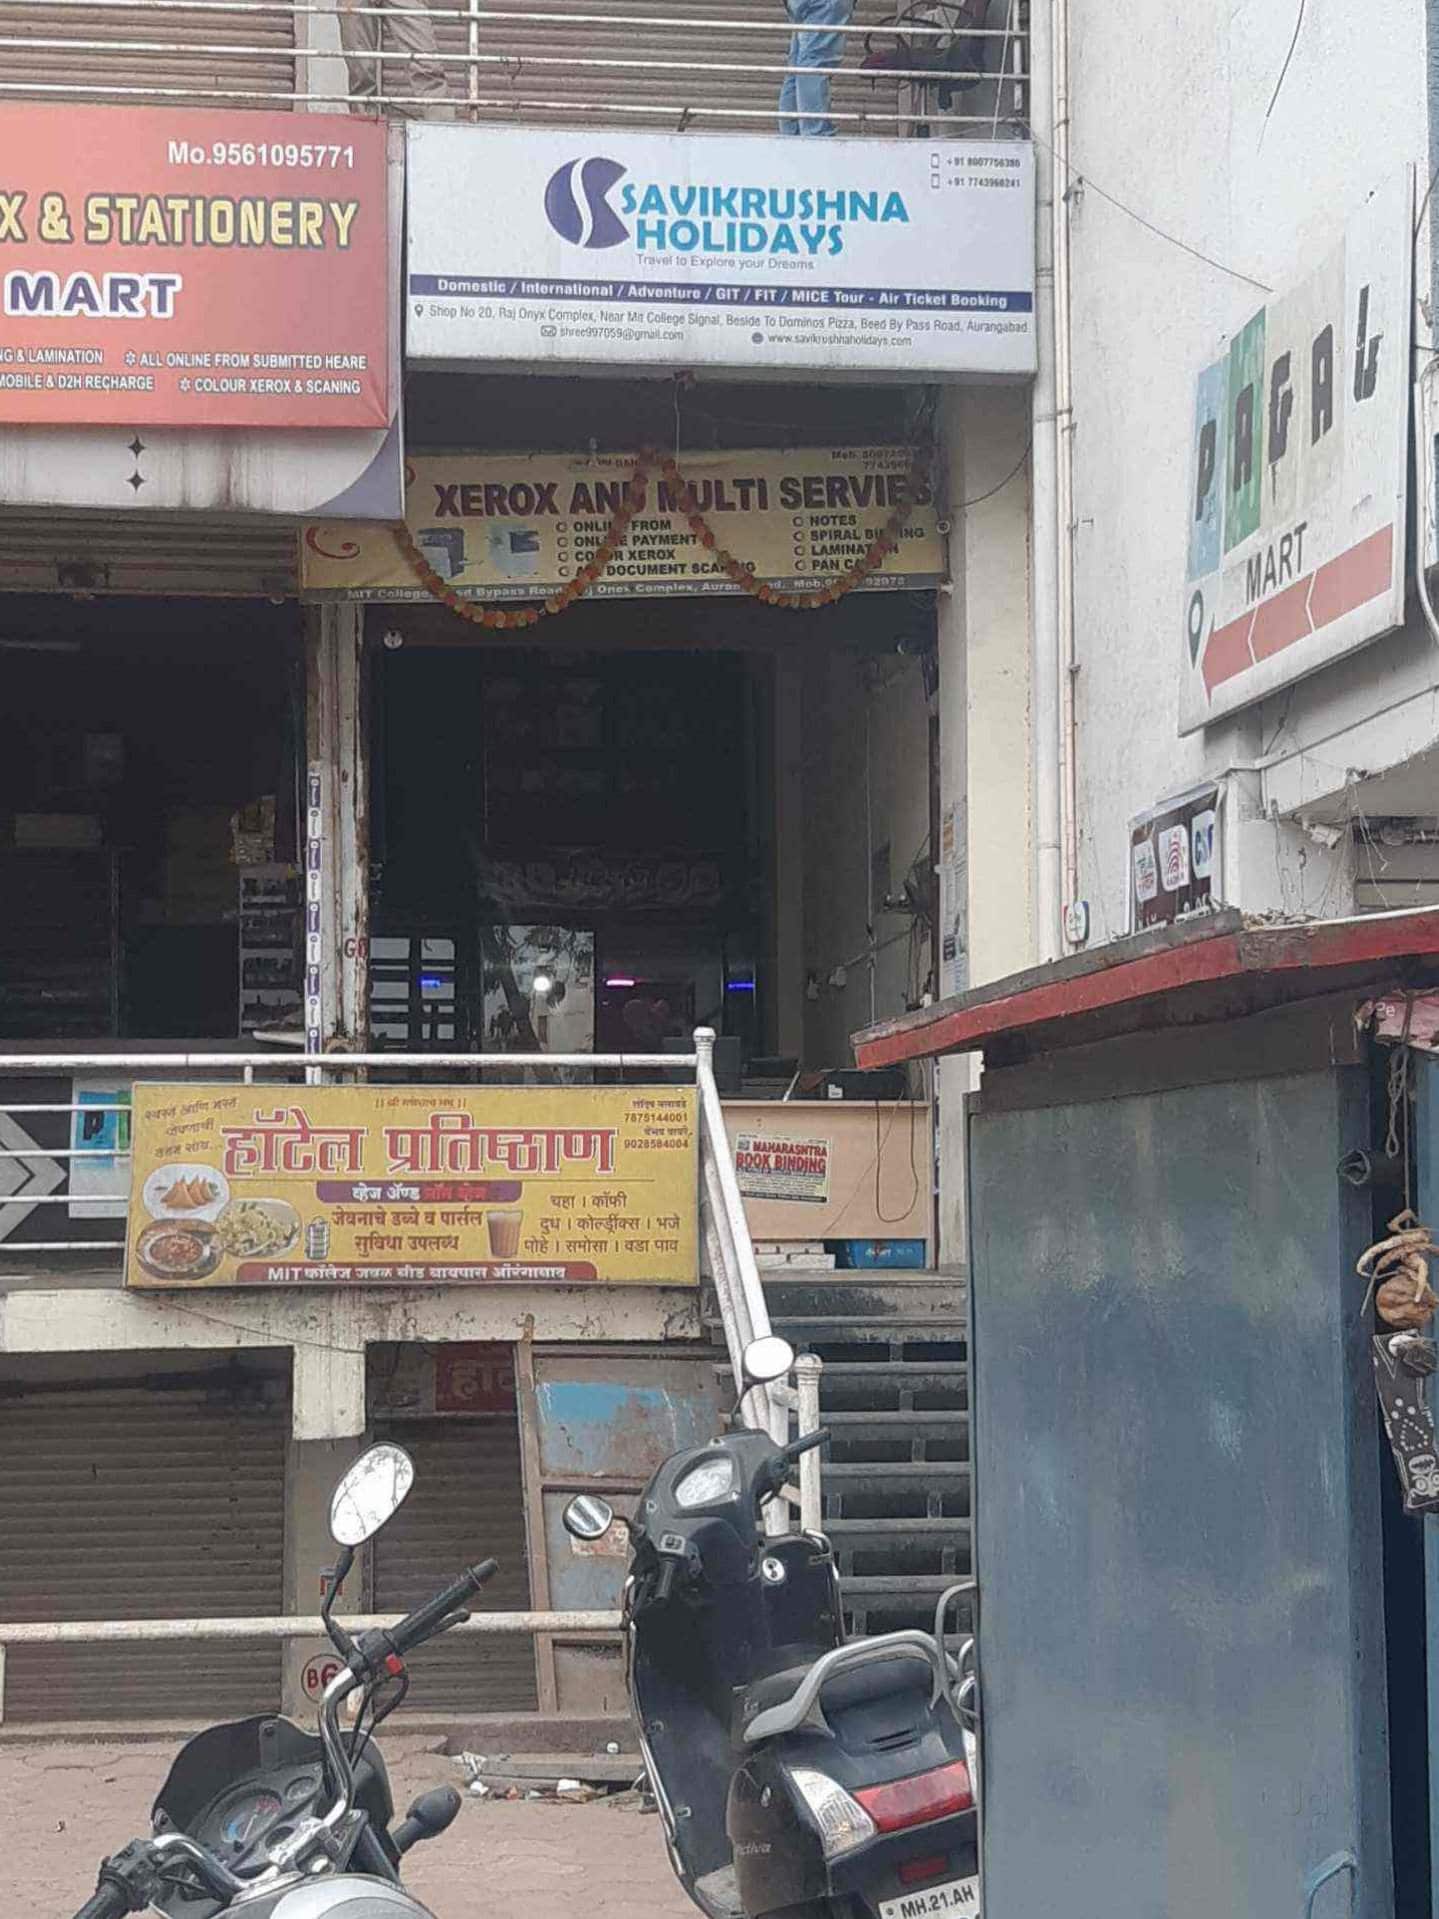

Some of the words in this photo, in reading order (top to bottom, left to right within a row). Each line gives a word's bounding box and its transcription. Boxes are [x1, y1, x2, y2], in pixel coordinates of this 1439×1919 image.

[167, 141, 355, 169] Mo.9561095771
[621, 183, 910, 224] SAVIKRUSHNA
[40, 194, 71, 242] &
[85, 195, 359, 249] STATIONERY
[636, 218, 843, 256] HOLIDAYS
[637, 254, 673, 266] Travel
[675, 255, 687, 266] to
[691, 256, 736, 269] Explore
[738, 259, 765, 271] your
[768, 257, 815, 270] Dreams
[6, 272, 180, 317] MART
[437, 278, 506, 294] Domestic
[521, 281, 613, 297] International
[628, 285, 701, 300] Adventure
[715, 289, 741, 301] GIT
[754, 289, 778, 301] FIT
[792, 290, 829, 303] MICE
[833, 291, 864, 304] Tour
[878, 293, 899, 305] Air
[904, 293, 946, 306] Ticket
[951, 294, 1007, 308] Booking
[429, 305, 457, 318] Shop
[460, 306, 475, 318] No
[519, 308, 546, 321] Onyx
[548, 309, 597, 323] Complex,
[600, 310, 624, 322] Near
[647, 311, 685, 326] College
[726, 314, 760, 326] Beside
[765, 315, 776, 327] To
[779, 316, 825, 328] Dominos
[861, 318, 886, 330] Beed
[889, 319, 903, 332] By
[906, 319, 931, 331] Pass
[967, 320, 1028, 334] Aurangabad
[29, 350, 104, 364] LAMINATION
[139, 353, 163, 367] ALL
[166, 353, 211, 368] ONLINE
[215, 354, 250, 368] FROM
[253, 355, 322, 370] SUBMITTED
[325, 355, 367, 370] HEARE
[58, 375, 82, 389] D2H
[85, 376, 154, 390] RECHARGE
[195, 379, 247, 393] COLOUR
[250, 379, 290, 393] XEROX
[306, 380, 361, 394] SCANING
[434, 481, 559, 518] XEROX
[656, 477, 769, 513] MULTI
[632, 519, 671, 531] FROM
[810, 514, 857, 526] NOTES
[632, 534, 698, 546] PAYMENT
[810, 529, 861, 541] SPIRAL
[628, 549, 676, 561] XEROX
[1245, 521, 1308, 605] MART
[607, 563, 687, 576] DOCUMENT
[812, 559, 839, 571] PAN
[221, 1106, 369, 1176] हॉटेल
[752, 1141, 828, 1157] MAHARASHTRA
[735, 1151, 771, 1169] BOOK
[551, 1194, 575, 1209] चहा
[592, 1190, 627, 1209] कॉफी
[440, 1205, 483, 1226] पार्सल
[656, 1213, 680, 1230] भजे
[354, 1230, 403, 1256] सुविधा
[408, 1234, 459, 1250] उपलब्ध
[524, 1236, 549, 1254] पोहे
[565, 1235, 608, 1252] समोसा
[624, 1239, 650, 1252] वडा
[654, 1239, 679, 1251] पाव
[267, 1267, 302, 1281] MIT
